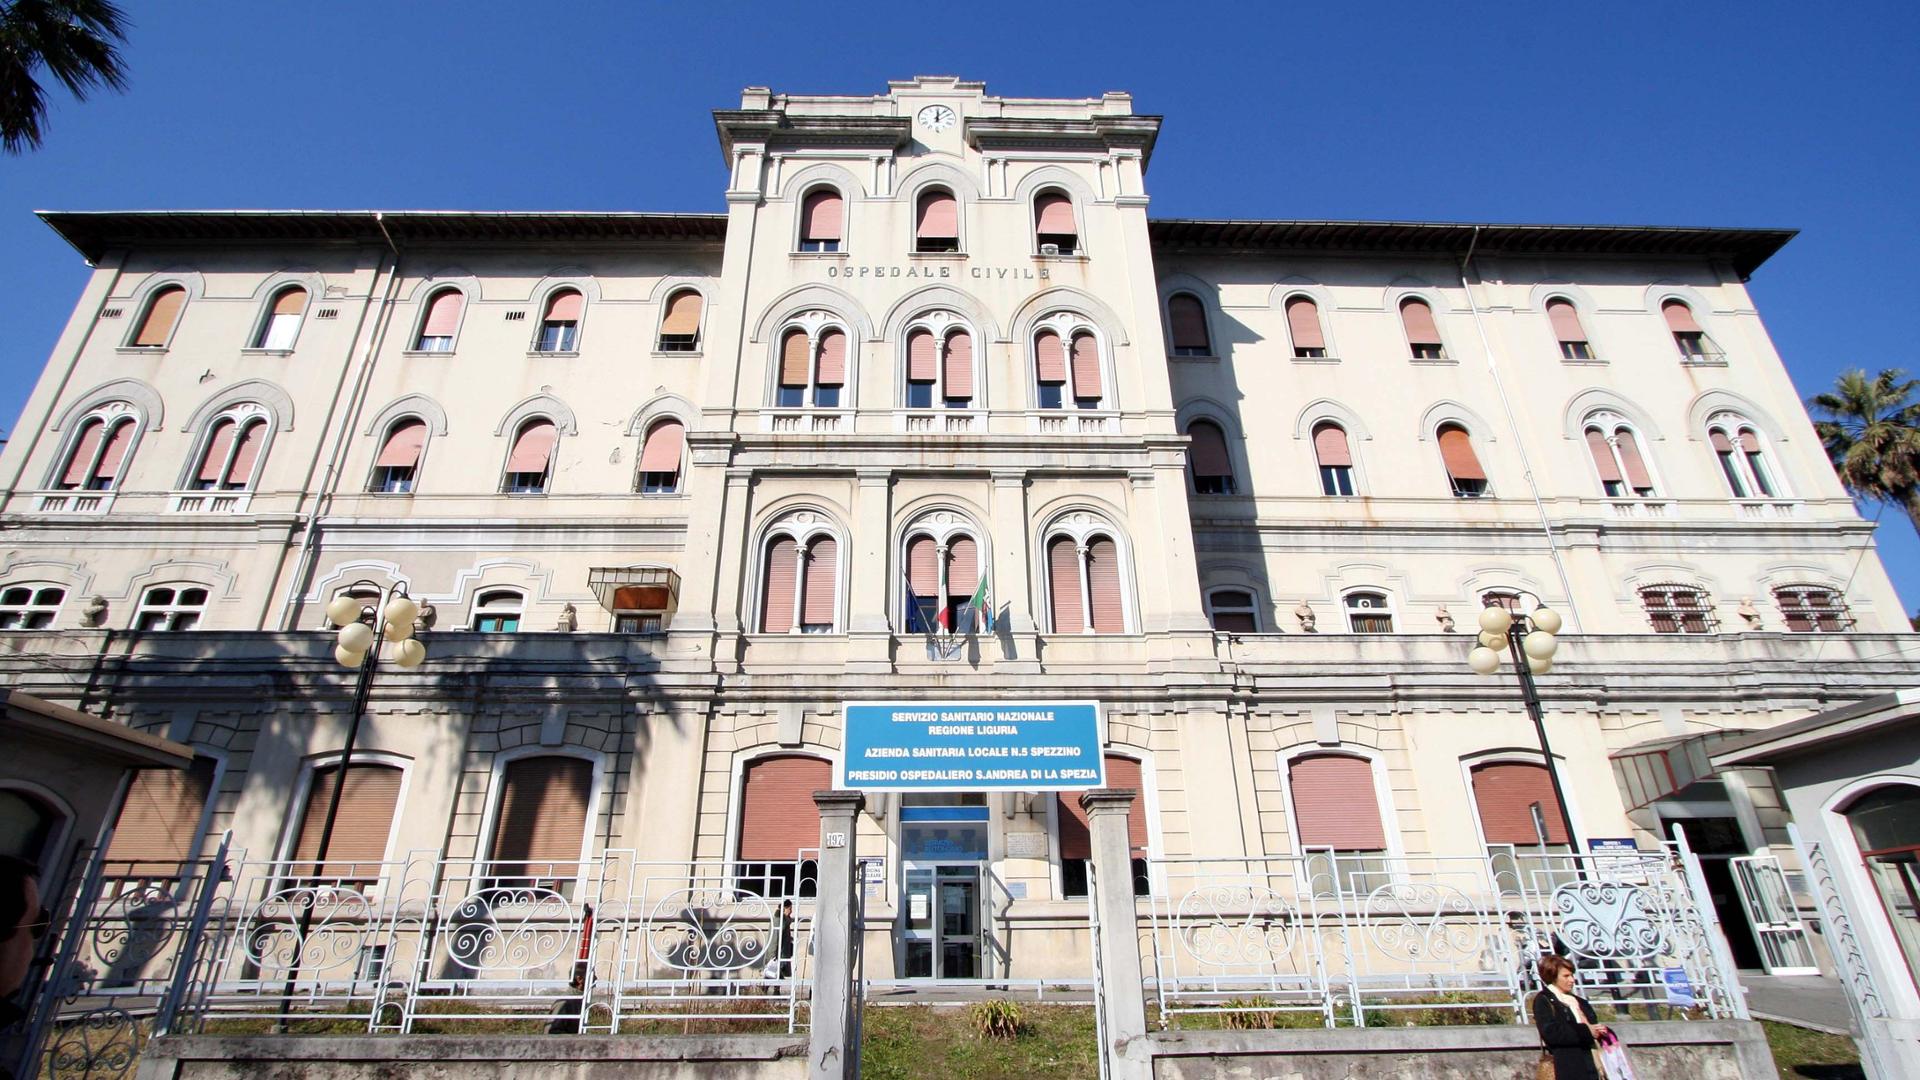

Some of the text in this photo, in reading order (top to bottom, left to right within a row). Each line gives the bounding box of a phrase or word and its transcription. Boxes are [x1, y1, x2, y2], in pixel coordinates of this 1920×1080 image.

[828, 266, 1050, 280] OSPEDALE CIVILE
[891, 711, 1055, 722] SERVIZIO SANITARIO NAZIONALE
[928, 725, 1019, 736] REGIONE LIGURIA
[864, 746, 1082, 758] AZIENDA SANITARIA LOCALE N.5 SPEZZINO
[848, 768, 1098, 781] PRESIDIO OSPEDALIERO S.ANDREA DI LA SPEZIA
